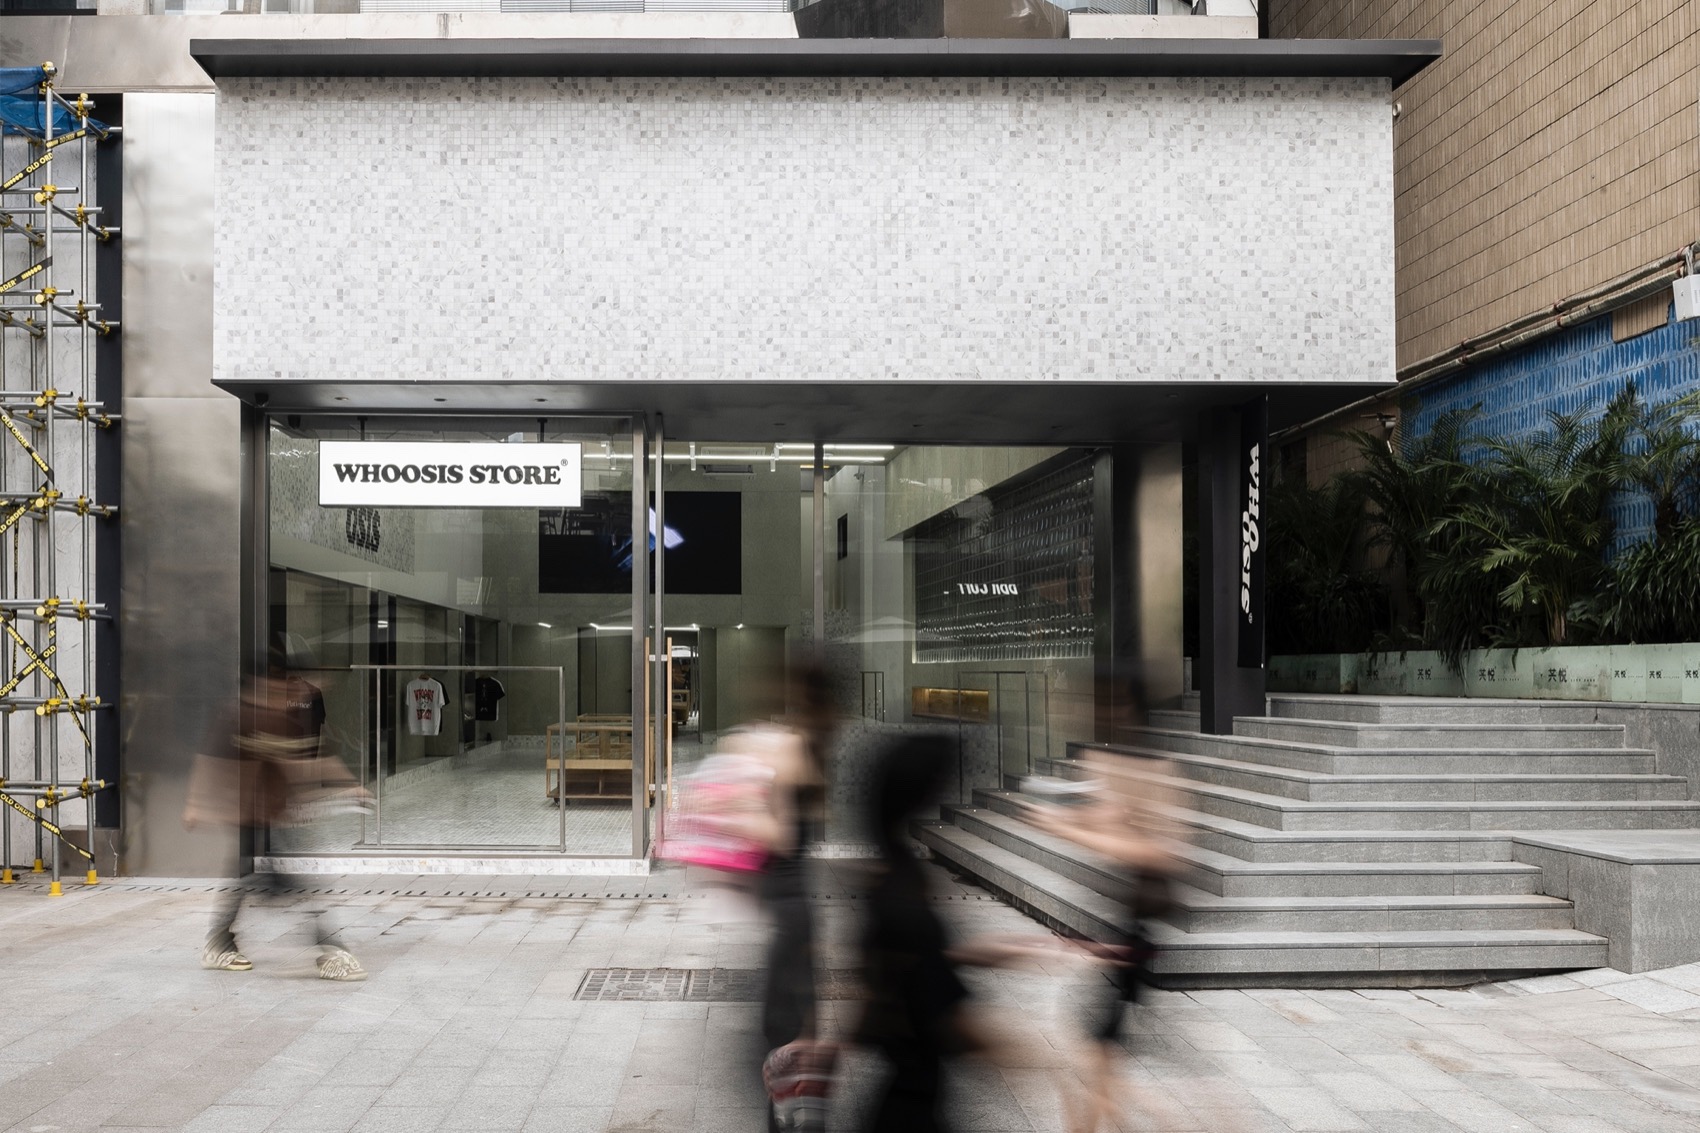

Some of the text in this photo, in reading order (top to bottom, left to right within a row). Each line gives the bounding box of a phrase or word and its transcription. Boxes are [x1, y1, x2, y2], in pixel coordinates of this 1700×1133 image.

[26, 161, 40, 173] OLD
[1, 414, 30, 449] OLD ORDER
[333, 463, 463, 484] WHOOSIS
[6, 506, 25, 526] ORDER
[43, 645, 56, 658] OLD
[25, 646, 37, 660] OLD
[36, 659, 55, 680] ORDER
[0, 677, 18, 696] ORDER
[1, 793, 36, 820] OLD ORDER
